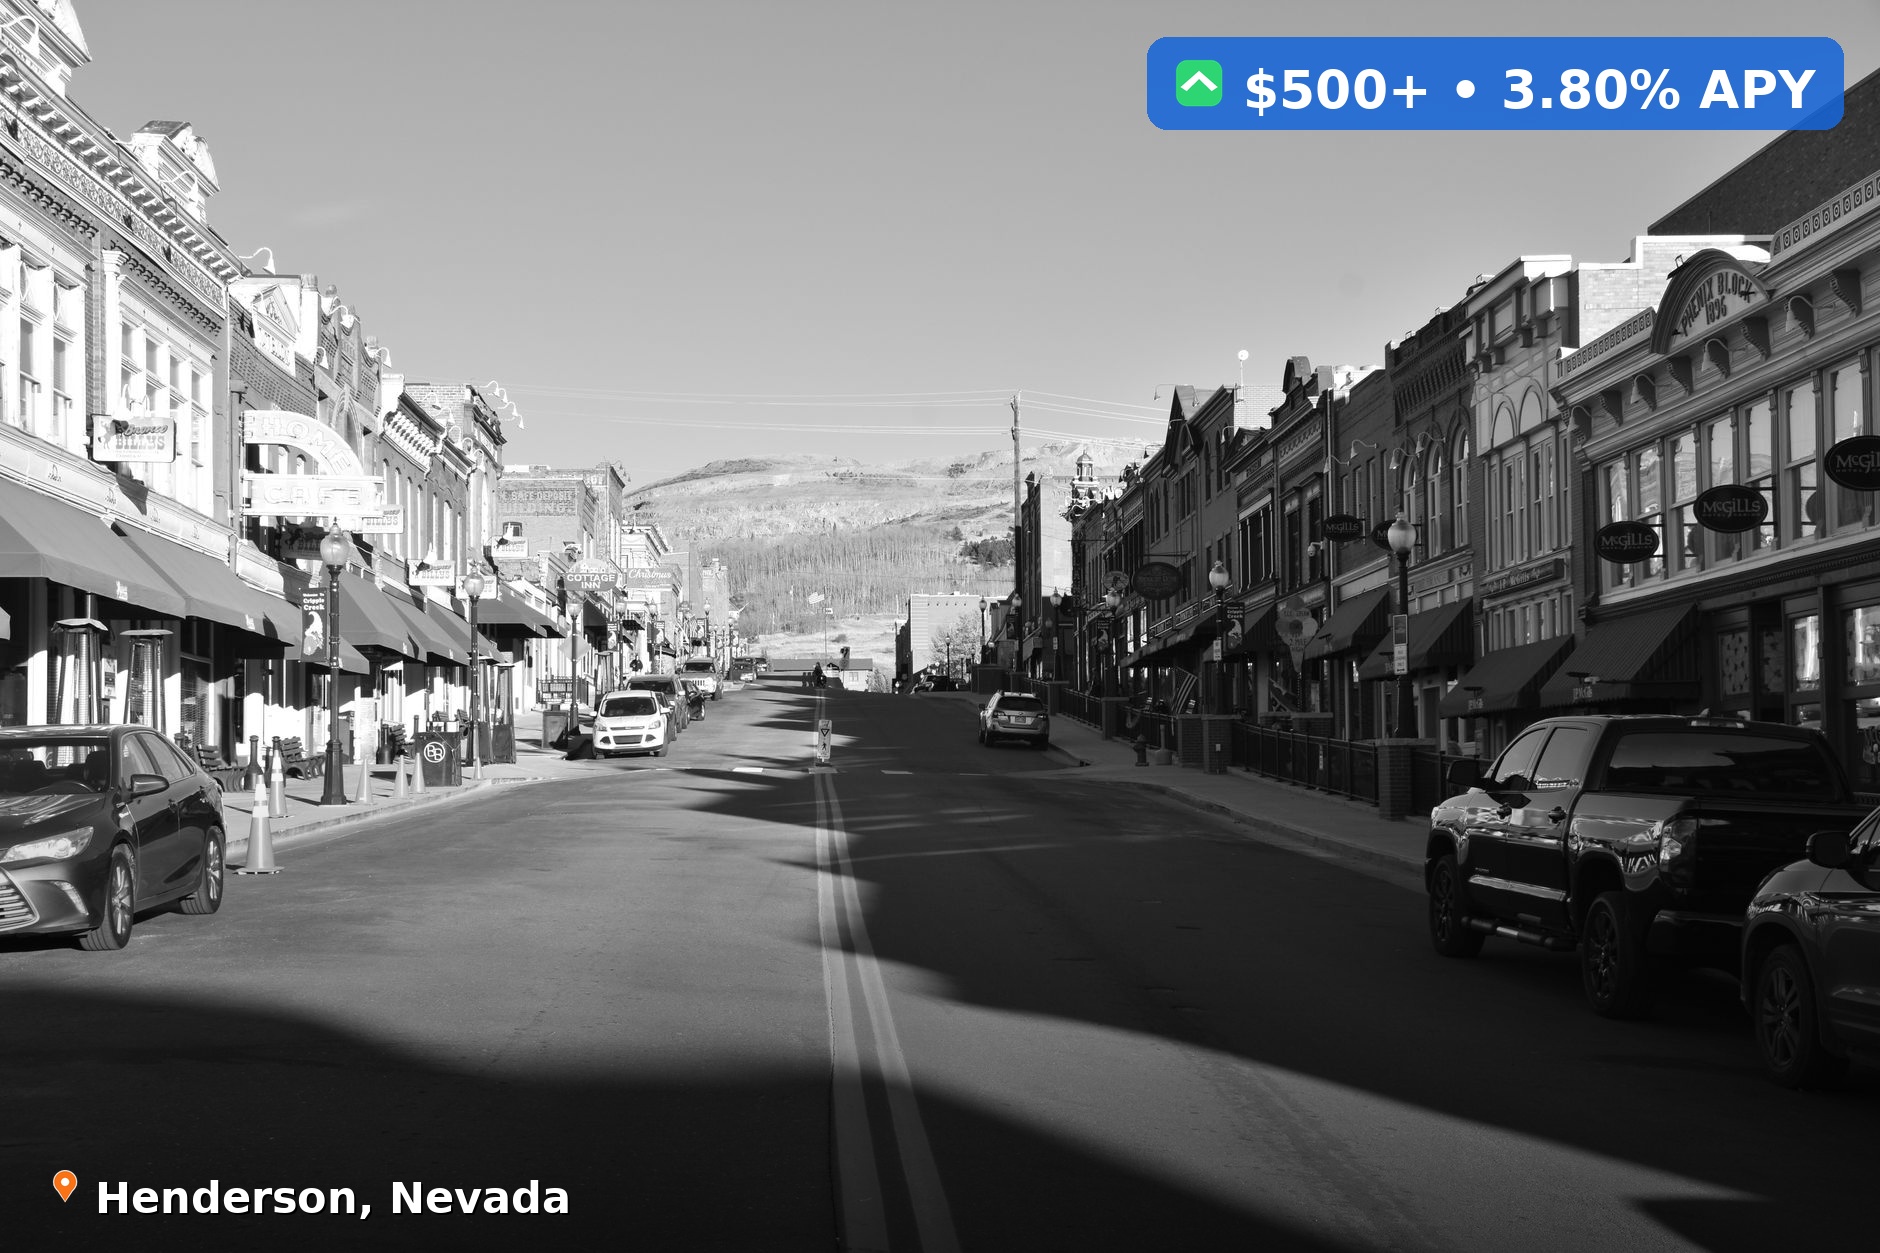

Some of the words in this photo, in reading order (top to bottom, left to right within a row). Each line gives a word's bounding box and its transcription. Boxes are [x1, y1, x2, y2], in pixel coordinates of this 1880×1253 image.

[1682, 277, 1713, 337] PHENIX
[1717, 272, 1753, 303] BLOCK
[123, 423, 169, 437] Bronco
[261, 416, 351, 474] HOME
[263, 485, 361, 505] CAFE
[567, 574, 615, 582] COTTAGE
[581, 581, 601, 589] INN
